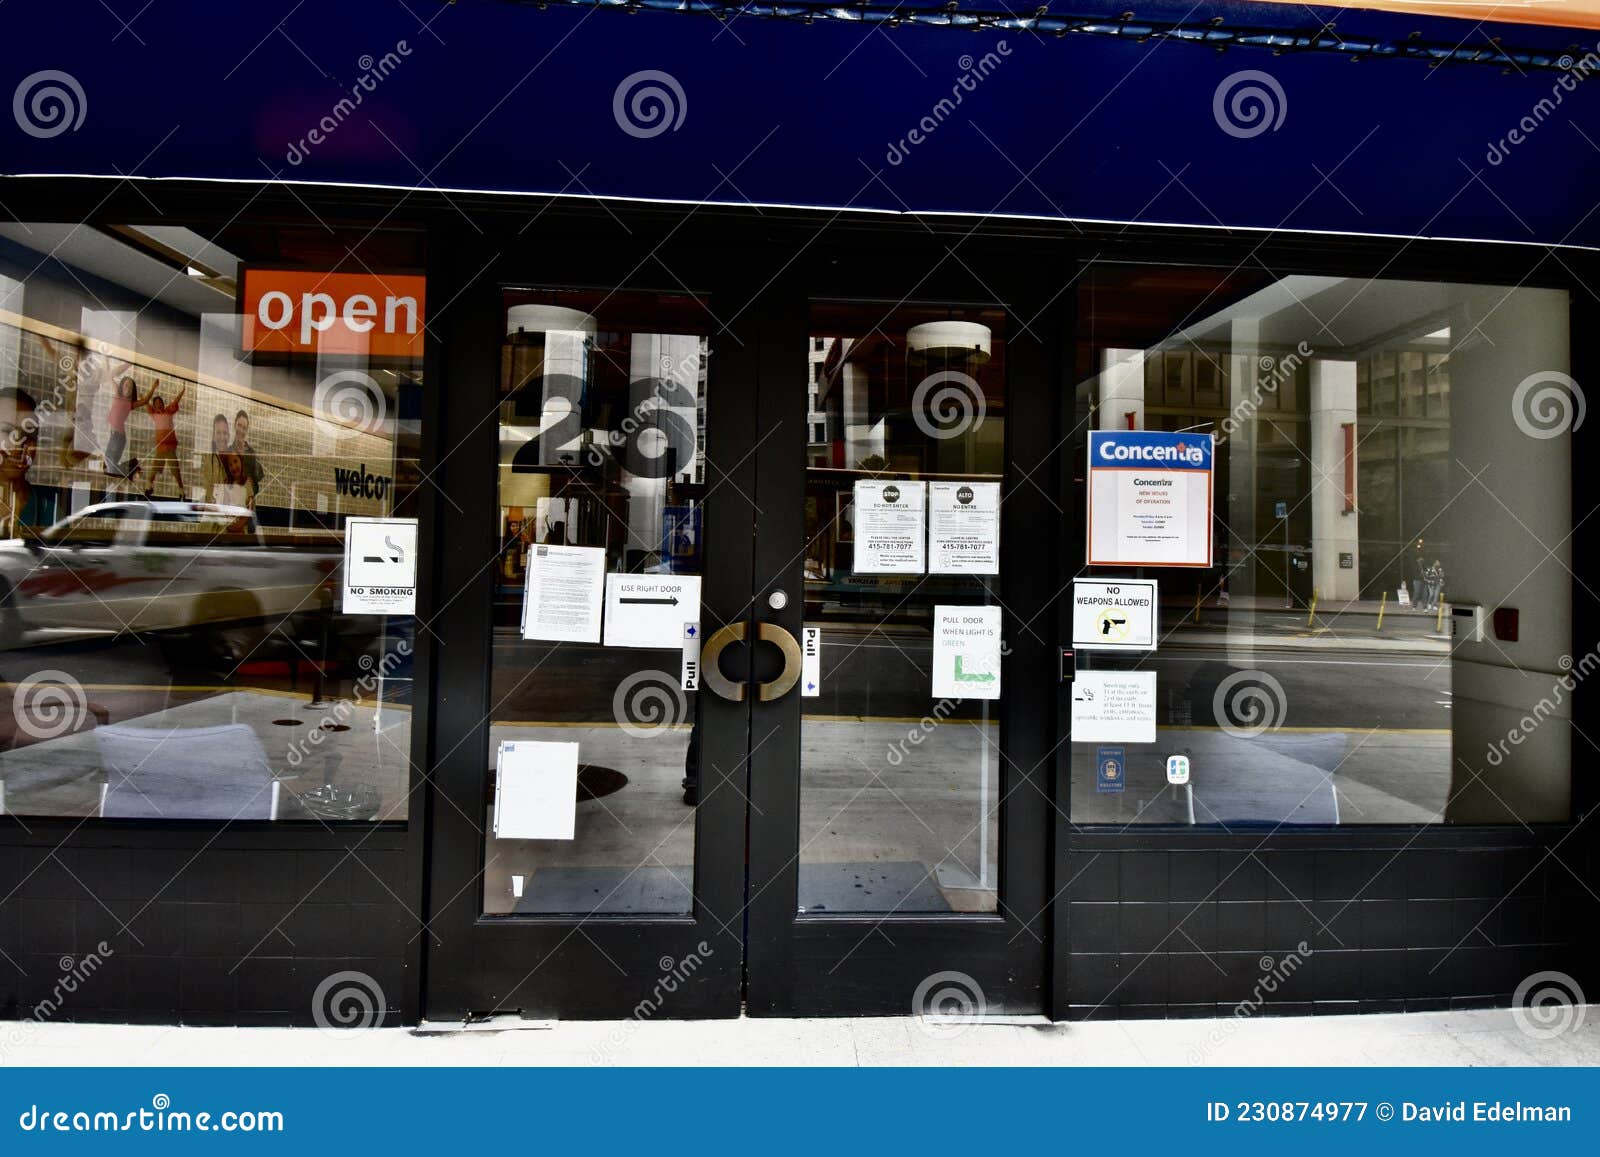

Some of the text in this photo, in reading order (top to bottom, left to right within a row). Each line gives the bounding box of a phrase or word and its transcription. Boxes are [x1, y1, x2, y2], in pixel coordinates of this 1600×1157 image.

[258, 290, 418, 345] open
[511, 373, 697, 479] 26
[1099, 441, 1204, 462] Concentra
[1133, 478, 1173, 487] Concentra
[350, 587, 413, 596] NO SMOKING
[660, 585, 682, 593] DOOR
[1106, 587, 1121, 595] NO
[1076, 597, 1150, 607] WEAPONS ALLOWED
[942, 616, 959, 624] PULL
[965, 628, 985, 636] LIGHT
[806, 629, 816, 656] Pull
[686, 661, 696, 689] Pull
